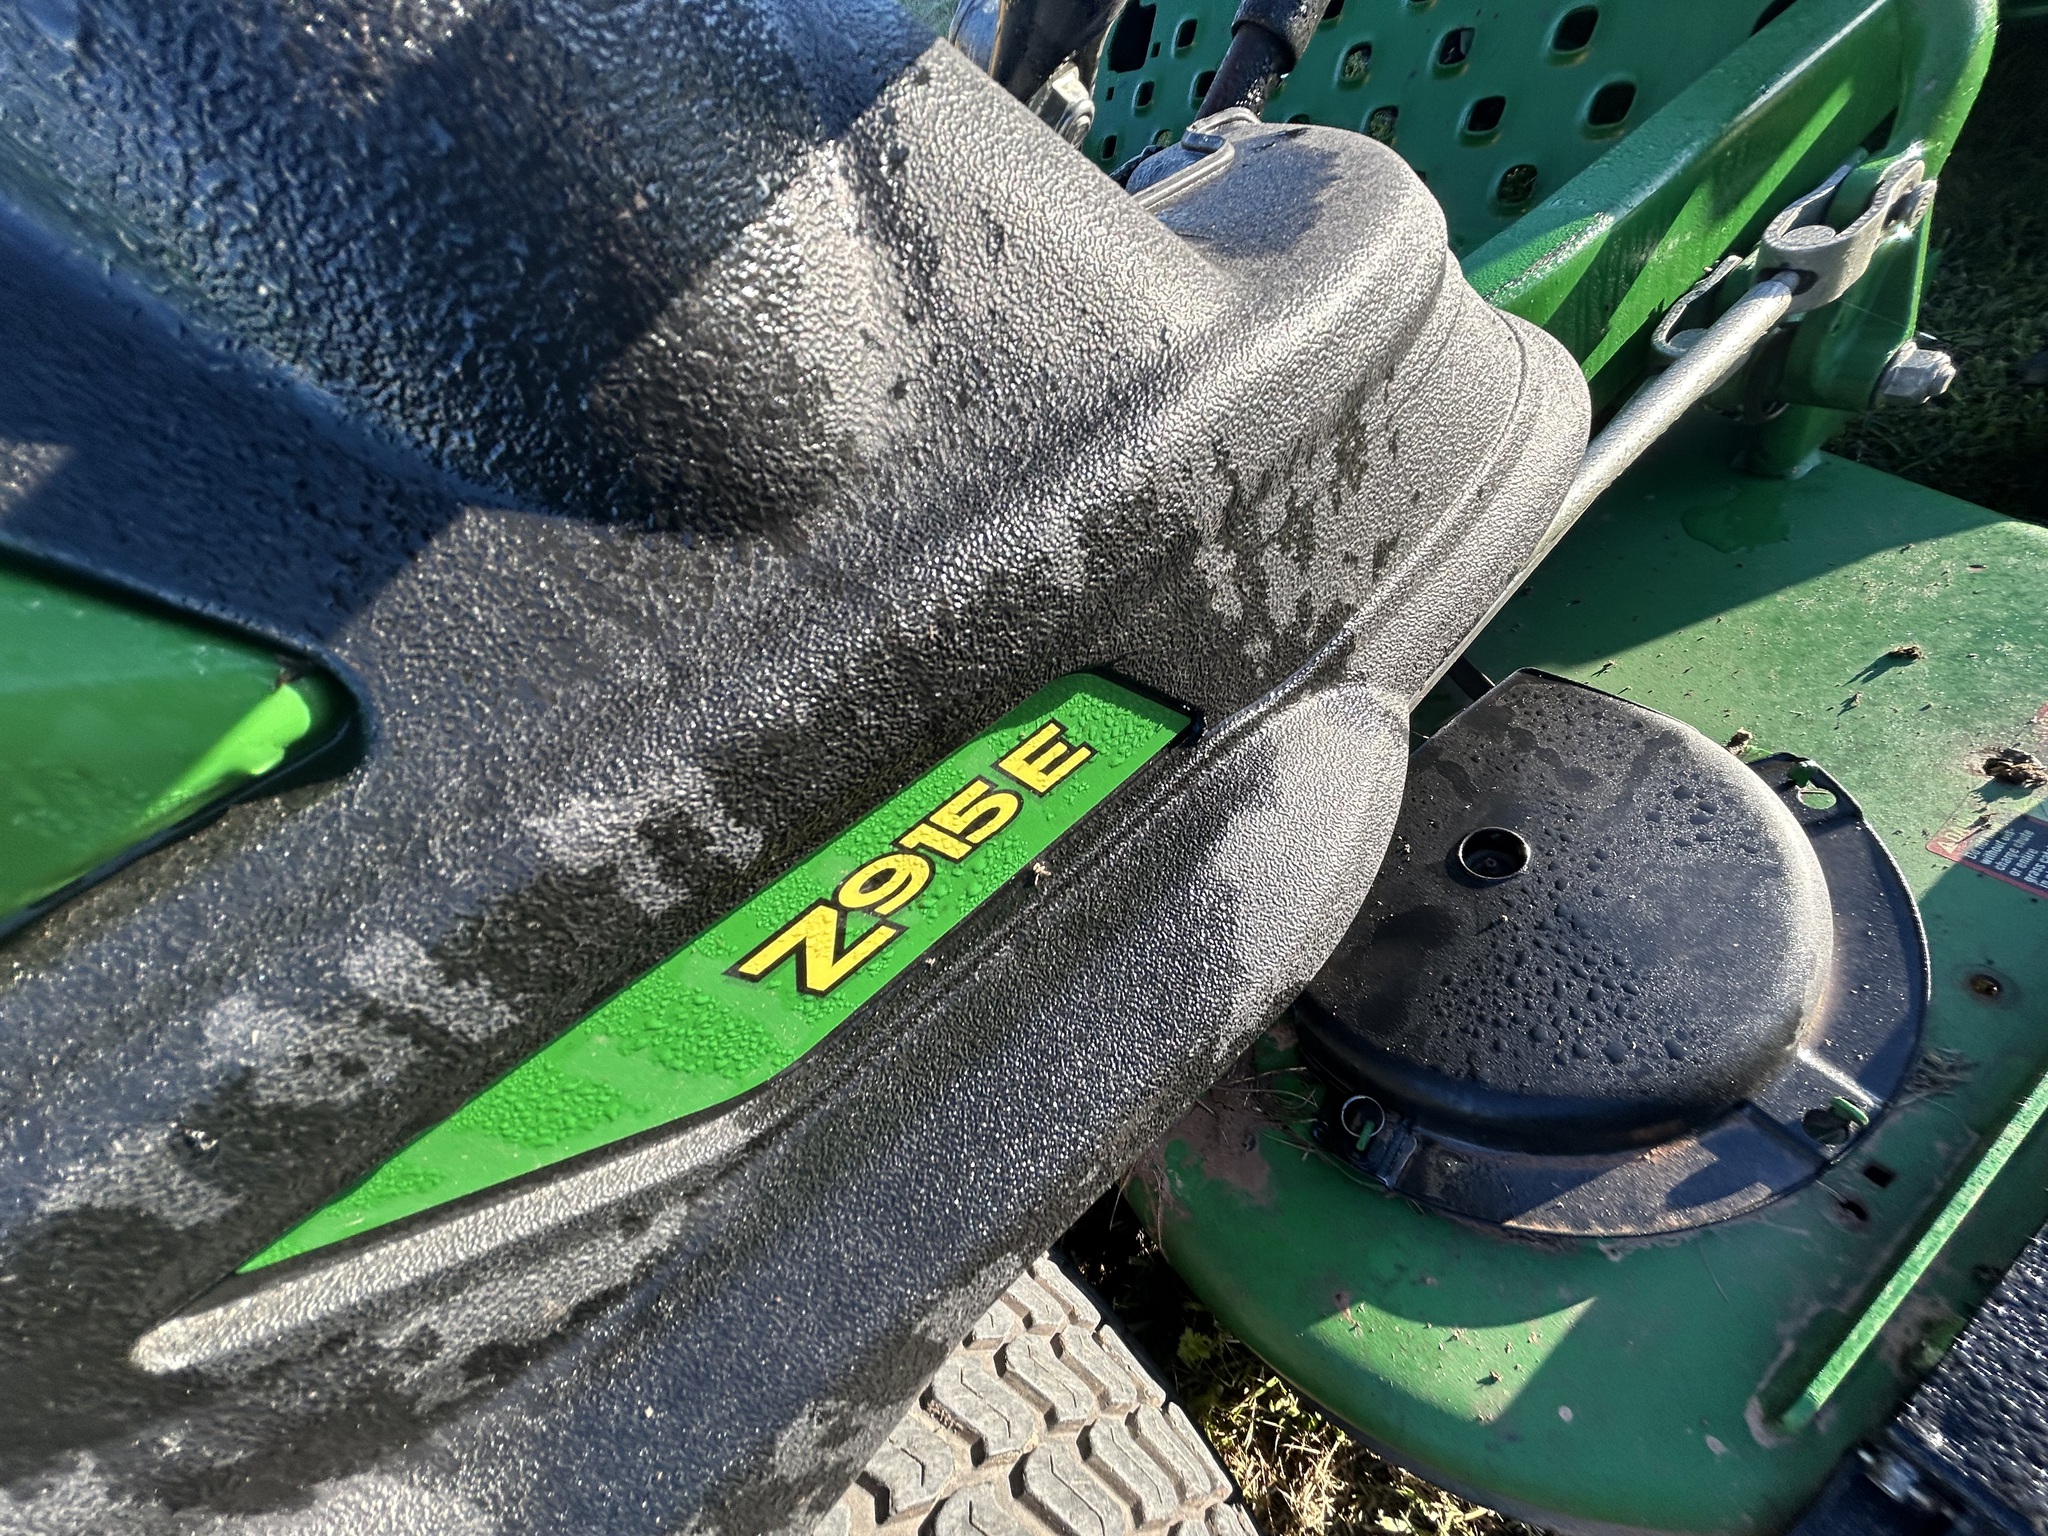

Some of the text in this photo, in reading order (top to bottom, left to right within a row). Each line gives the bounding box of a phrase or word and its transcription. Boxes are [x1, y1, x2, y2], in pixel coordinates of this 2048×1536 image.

[1980, 839, 2005, 865] without
[1995, 829, 2035, 871] charge chute
[2009, 848, 2039, 877] or entire
[2024, 862, 2046, 884] grass
